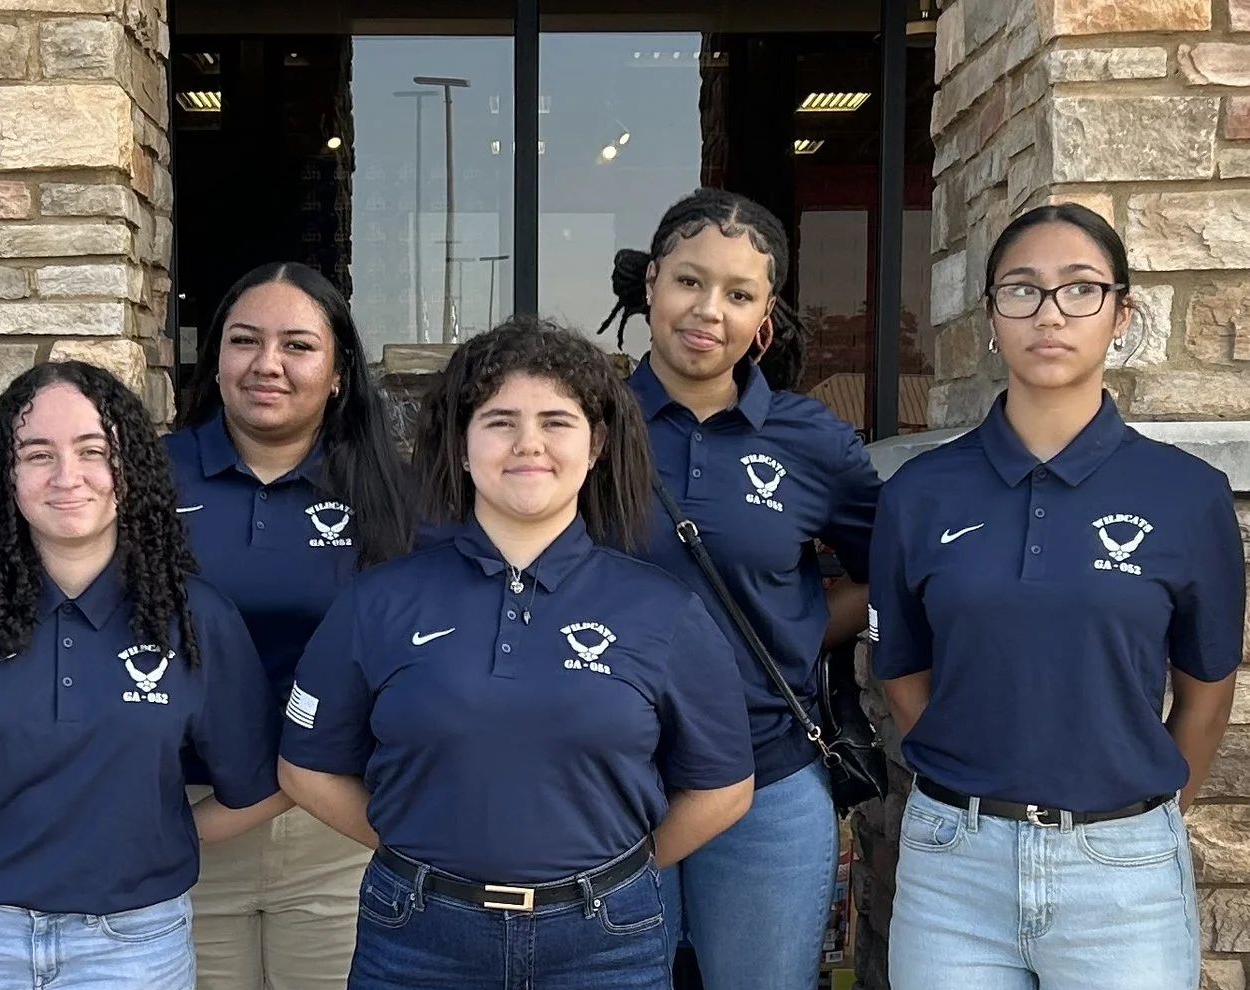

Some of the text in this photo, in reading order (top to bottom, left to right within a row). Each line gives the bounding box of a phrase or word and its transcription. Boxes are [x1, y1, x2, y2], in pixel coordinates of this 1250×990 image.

[740, 454, 787, 477] WILDCATS
[1092, 513, 1154, 533] WILDCATS
[559, 622, 617, 643] WILDCATS
[117, 644, 176, 660] WILDCAS
